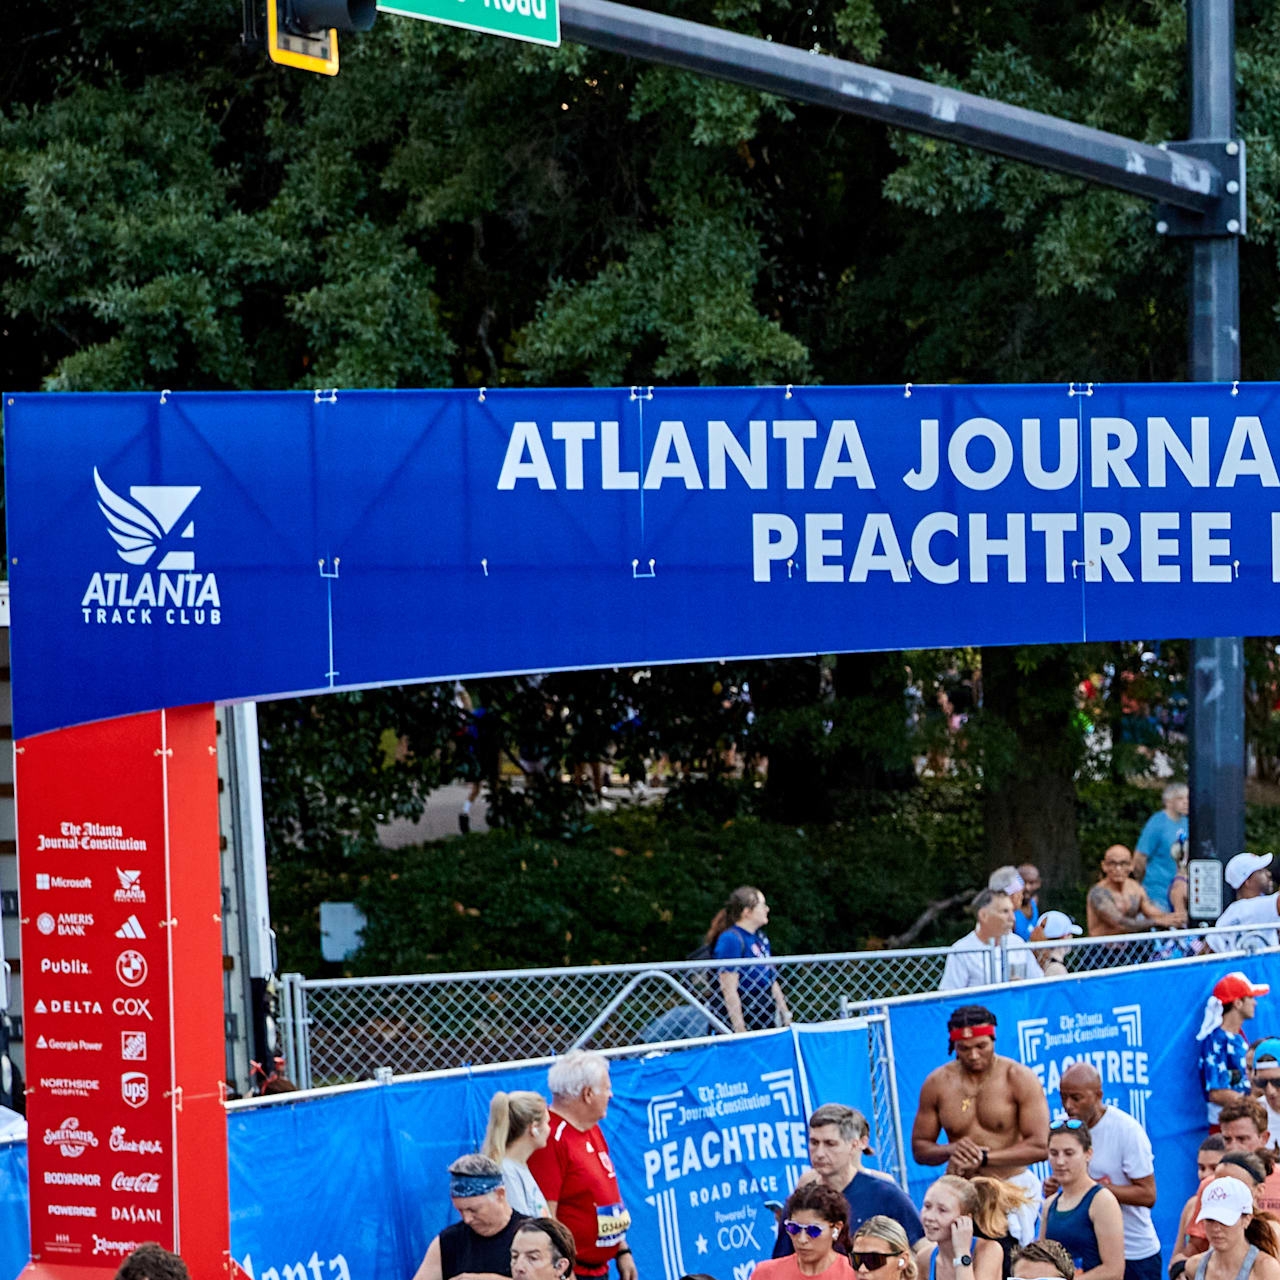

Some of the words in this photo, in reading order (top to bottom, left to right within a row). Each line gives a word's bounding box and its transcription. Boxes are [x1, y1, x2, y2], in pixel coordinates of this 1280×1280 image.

[482, 0, 548, 20] oad
[496, 420, 876, 492] ATLANTA
[752, 510, 1232, 585] PEACHTREE
[81, 572, 221, 607] ATLANTA
[83, 608, 152, 624] TRACK
[166, 608, 221, 624] CLUB
[60, 822, 81, 836] The
[83, 822, 122, 837] Atlanta
[37, 834, 147, 851] Journal-Constitution
[51, 877, 92, 888] Microsoft
[58, 914, 94, 925] AMERIS
[58, 924, 86, 936] BANK
[41, 958, 89, 973] Publix
[51, 1001, 102, 1014] DELTA
[113, 998, 153, 1021] COX
[48, 1039, 77, 1051] Georgia
[124, 1082, 146, 1103] ups
[698, 1084, 716, 1103] The
[717, 1080, 748, 1101] Atlanta
[643, 1120, 807, 1188] PEACHTREE
[690, 1180, 734, 1206] ROAD
[740, 1176, 778, 1197] RACE
[715, 1208, 744, 1223] Powered
[747, 1205, 757, 1221] by
[717, 1221, 761, 1251] COX
